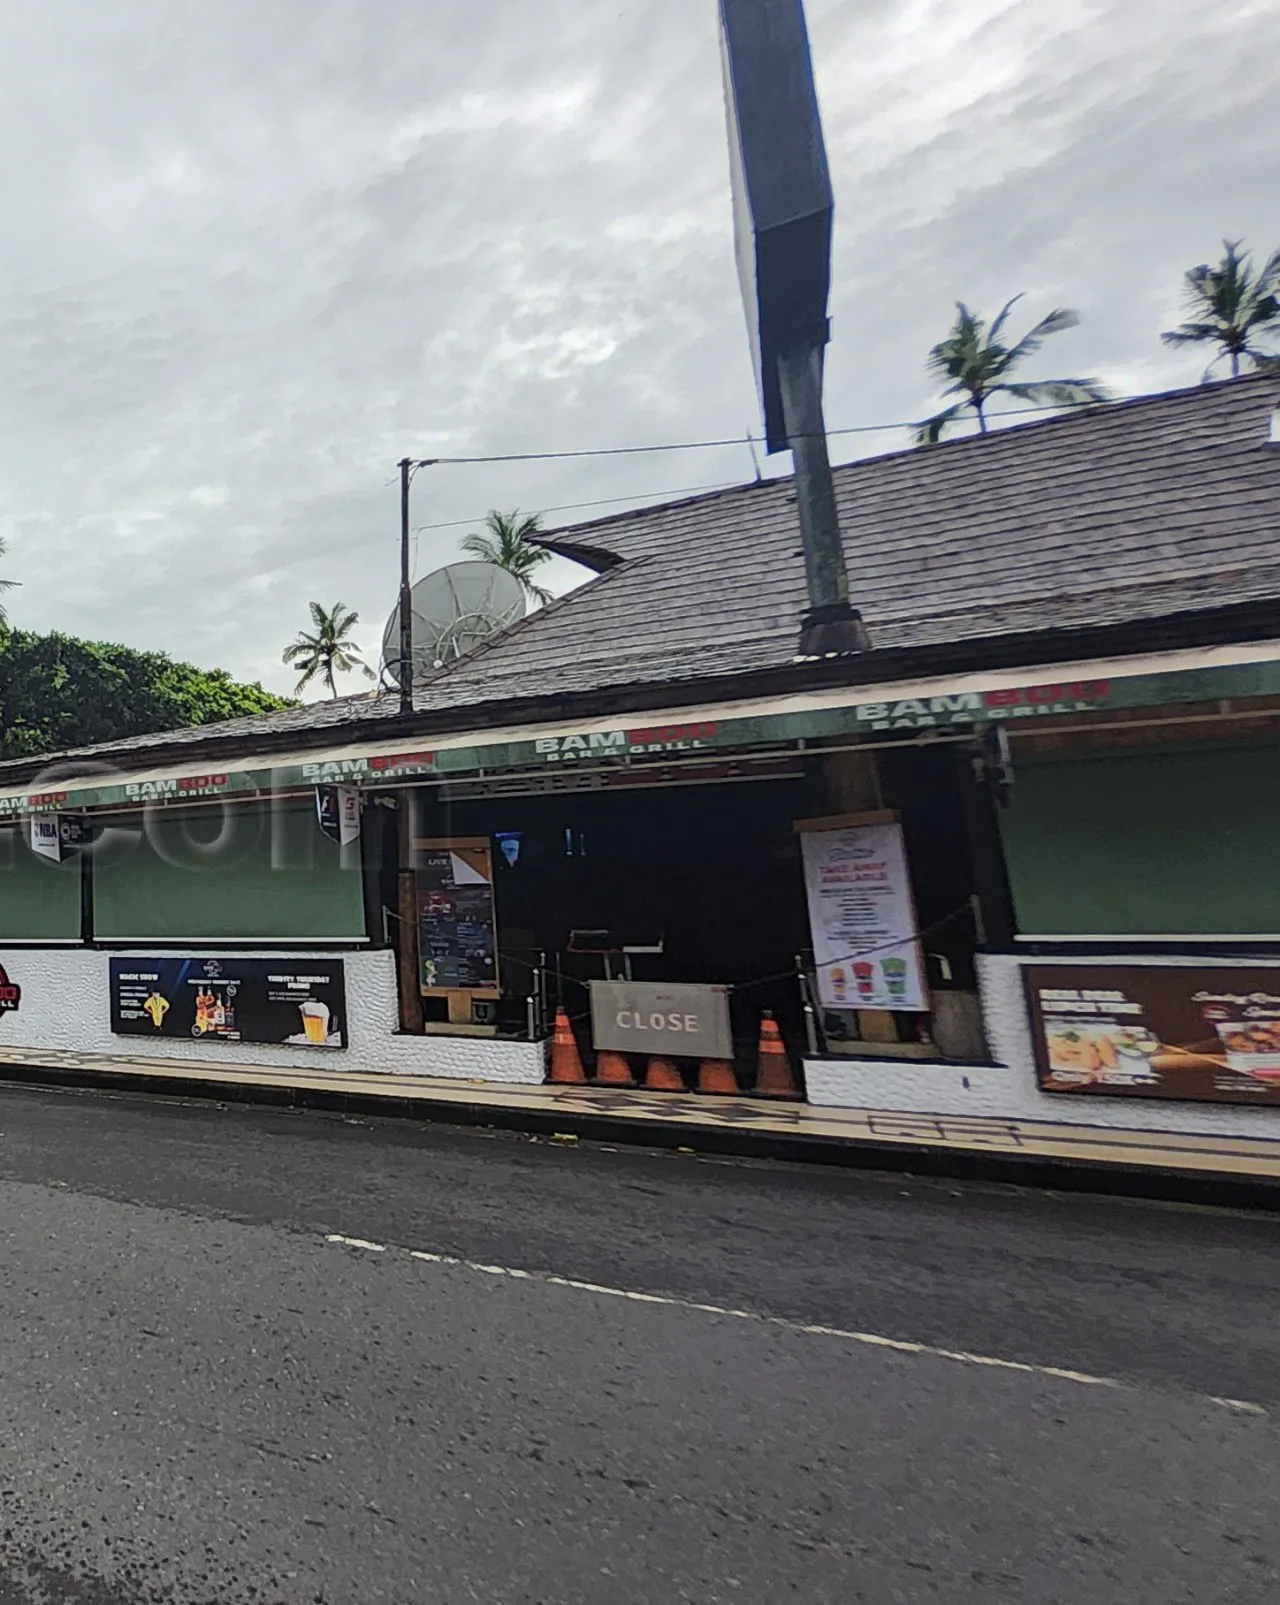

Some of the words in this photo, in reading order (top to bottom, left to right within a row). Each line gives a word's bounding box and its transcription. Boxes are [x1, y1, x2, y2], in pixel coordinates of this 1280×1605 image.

[856, 680, 1110, 720] BAMBOO
[872, 716, 936, 731] BAR
[987, 701, 1098, 719] GRILL
[535, 723, 717, 753] BAMBOO
[546, 750, 592, 762] BAR
[629, 739, 707, 754] GRILL
[302, 753, 433, 777] BAMBOO
[311, 775, 344, 784] BAR
[371, 767, 427, 777] GRILL
[616, 1011, 699, 1033] CLOSE
